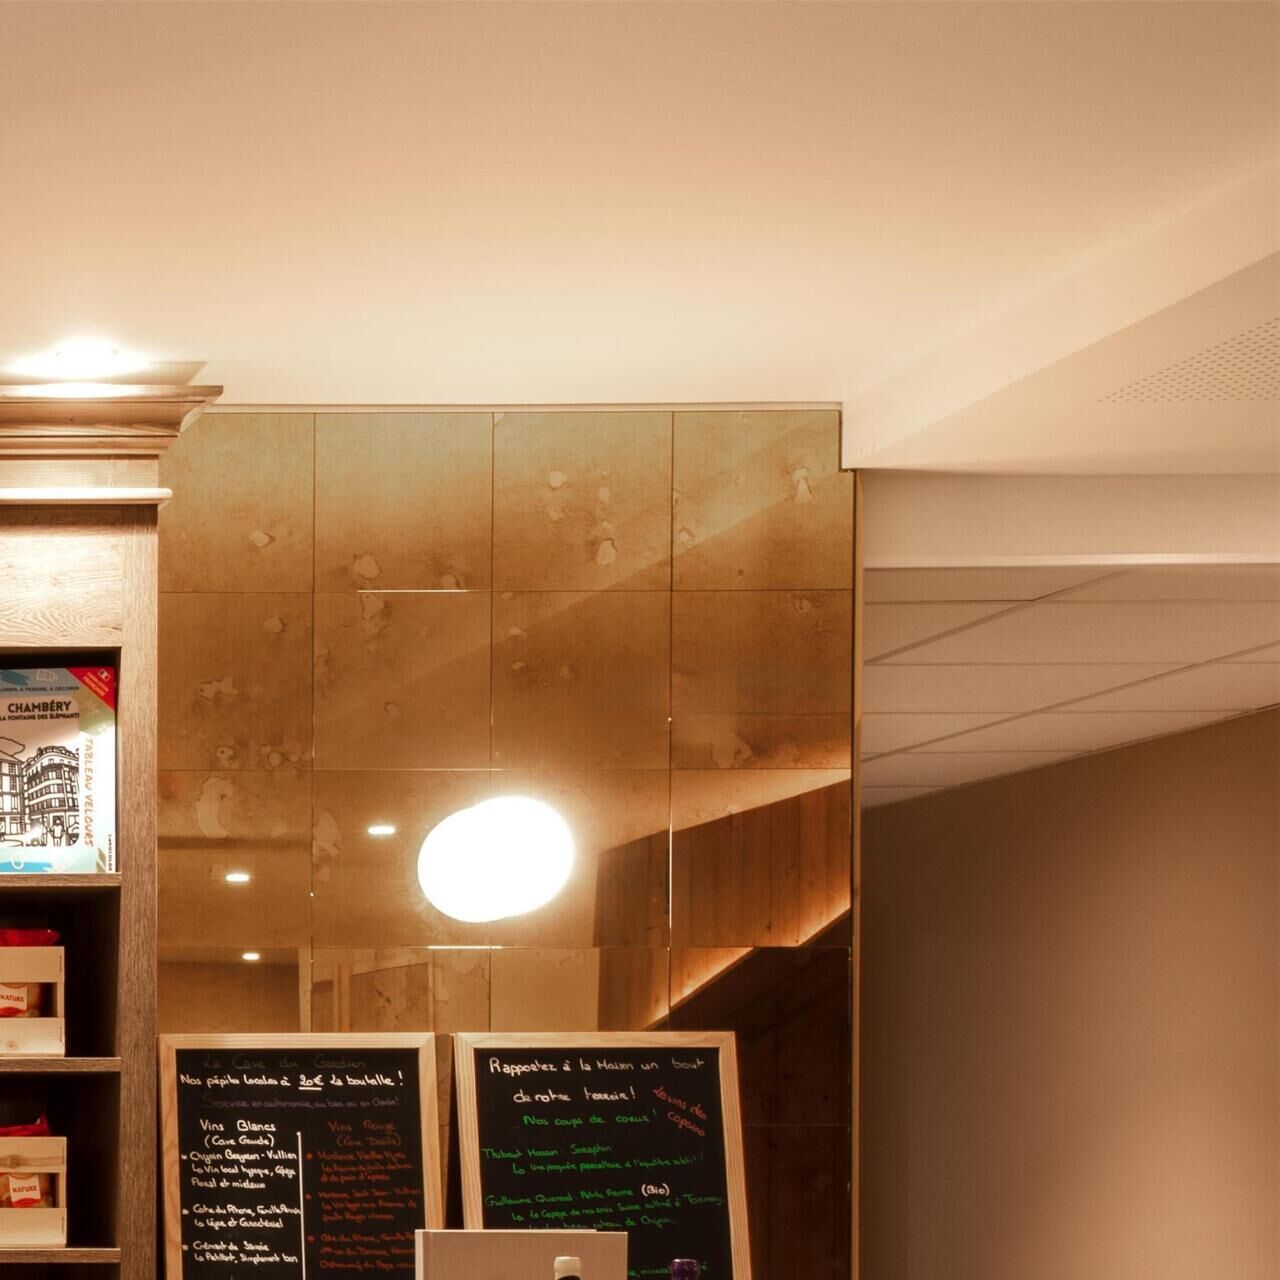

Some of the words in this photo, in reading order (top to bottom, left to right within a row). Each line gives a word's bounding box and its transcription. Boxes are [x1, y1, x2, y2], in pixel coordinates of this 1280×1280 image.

[7, 699, 73, 713] CHAMBÉRY
[84, 735, 96, 791] TABLEAU
[83, 793, 96, 849] VELOURS
[0, 993, 26, 1003] NATURE
[490, 1056, 558, 1078] Rapportez
[562, 1059, 572, 1073] à
[579, 1057, 592, 1072] la
[640, 1061, 659, 1072] un
[670, 1056, 705, 1070] bout
[180, 1074, 203, 1086] Nos
[280, 1076, 292, 1087] à
[512, 1090, 533, 1103] de
[534, 1088, 572, 1103] notre
[200, 1119, 225, 1132] Vins
[236, 1119, 278, 1132] Blancs
[328, 1120, 353, 1132] Vins
[523, 1113, 549, 1126] Nos
[555, 1115, 584, 1128] coups
[588, 1113, 606, 1125] de
[11, 1184, 39, 1194] NATURE
[641, 1182, 671, 1198] (Bio)
